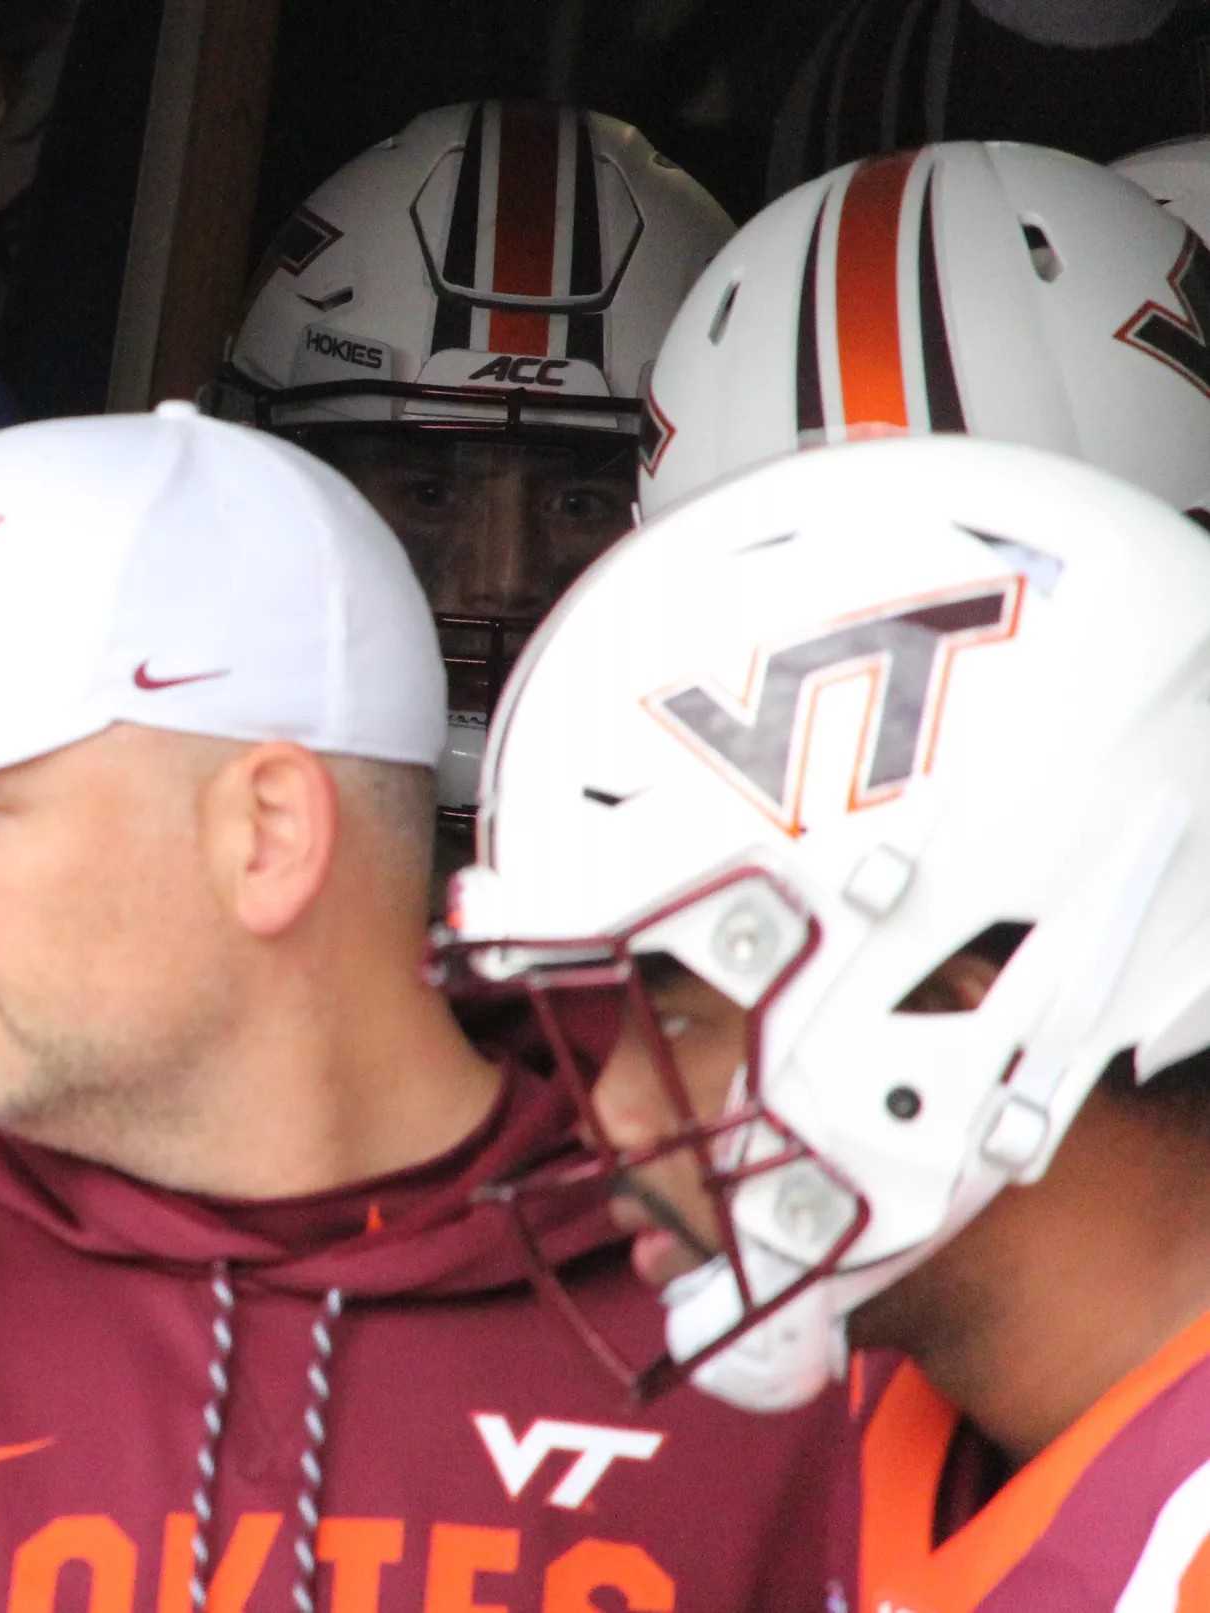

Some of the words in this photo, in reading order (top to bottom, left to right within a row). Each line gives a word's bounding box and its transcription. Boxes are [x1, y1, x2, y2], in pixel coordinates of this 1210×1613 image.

[307, 329, 383, 369] HOKIES
[468, 355, 569, 387] ACC
[639, 572, 1026, 840] VT
[471, 1413, 665, 1510] VT
